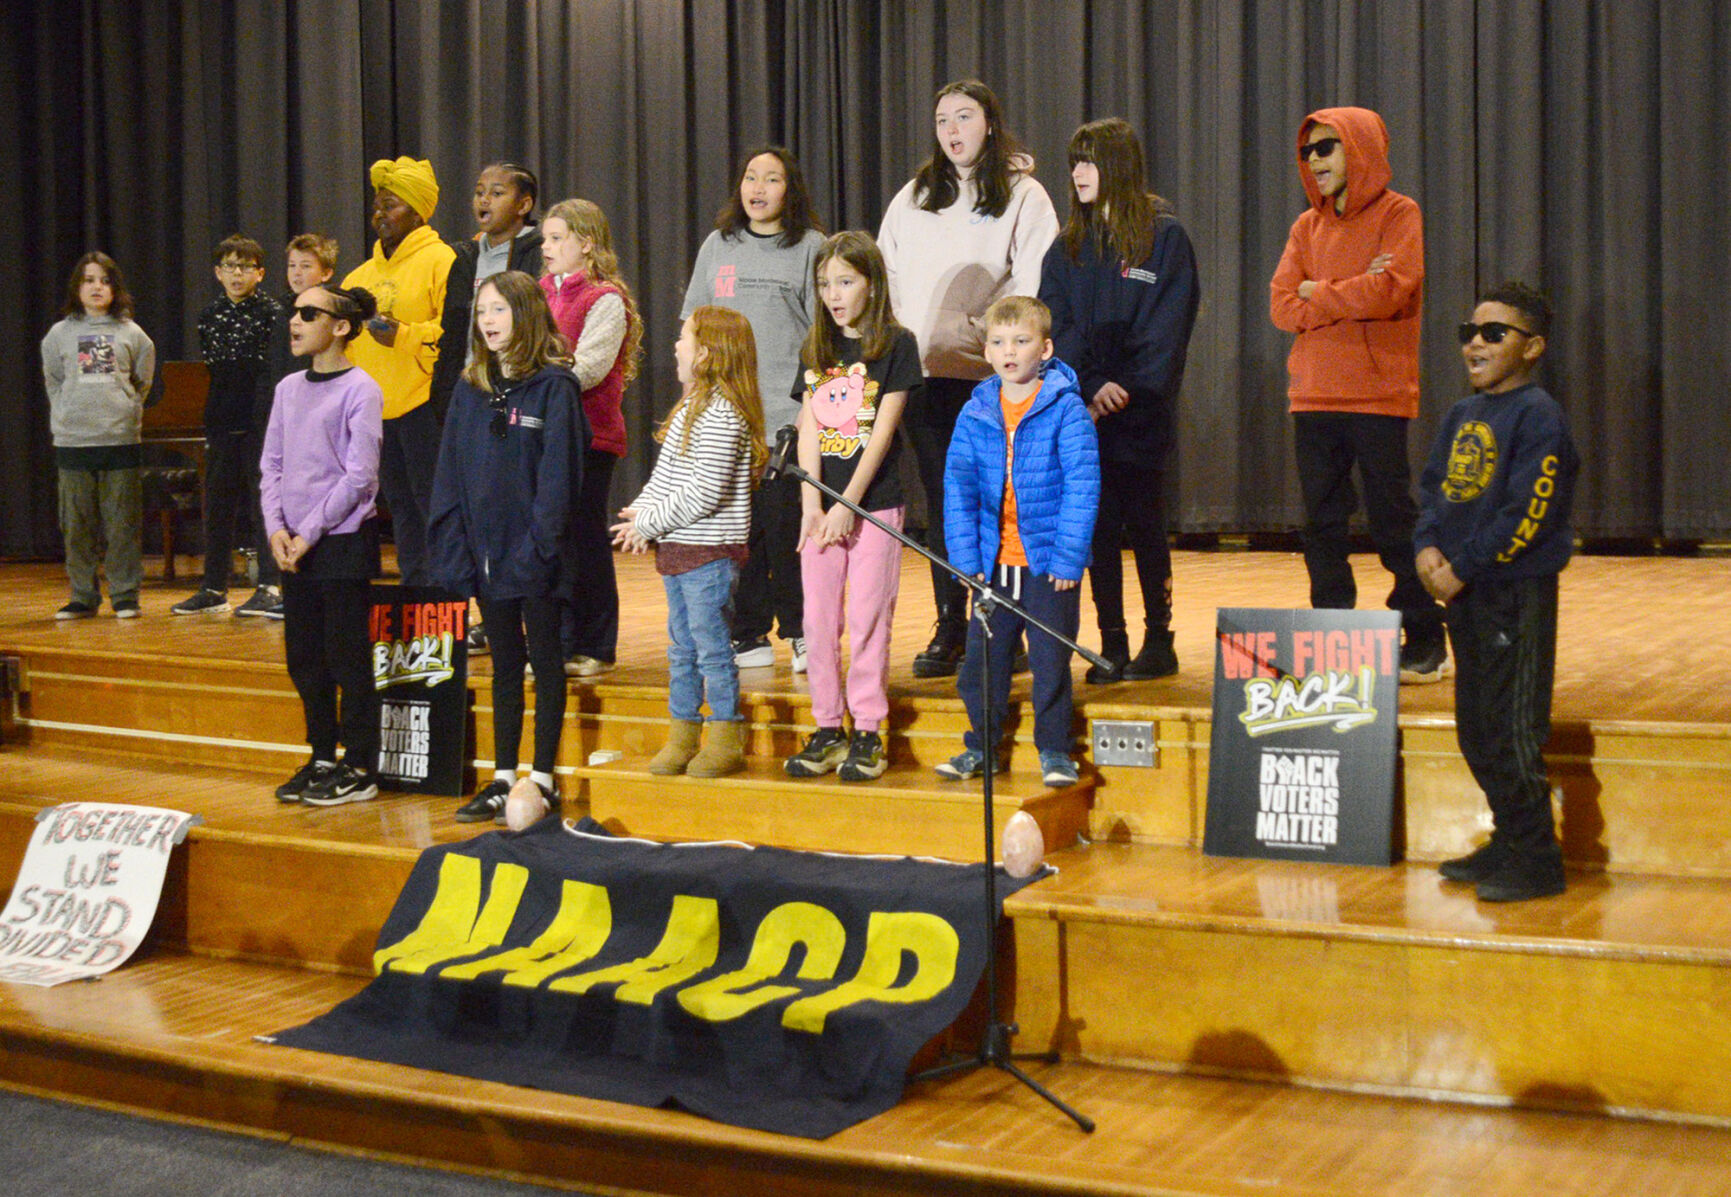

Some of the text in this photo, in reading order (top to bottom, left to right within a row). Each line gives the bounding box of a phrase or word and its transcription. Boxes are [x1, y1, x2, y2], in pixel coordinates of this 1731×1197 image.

[402, 601, 467, 641] FIGHT
[373, 632, 453, 675] BACK!
[1220, 629, 1398, 680] WE FIGHT
[1240, 665, 1376, 722] BACK!
[381, 729, 430, 754] VOTERS
[378, 751, 429, 778] MATTER
[1260, 783, 1340, 815] VOTERS
[43, 803, 180, 855] TOGETHER
[1256, 811, 1338, 844] MATTER
[64, 849, 123, 890] WE
[8, 884, 132, 939] STAND
